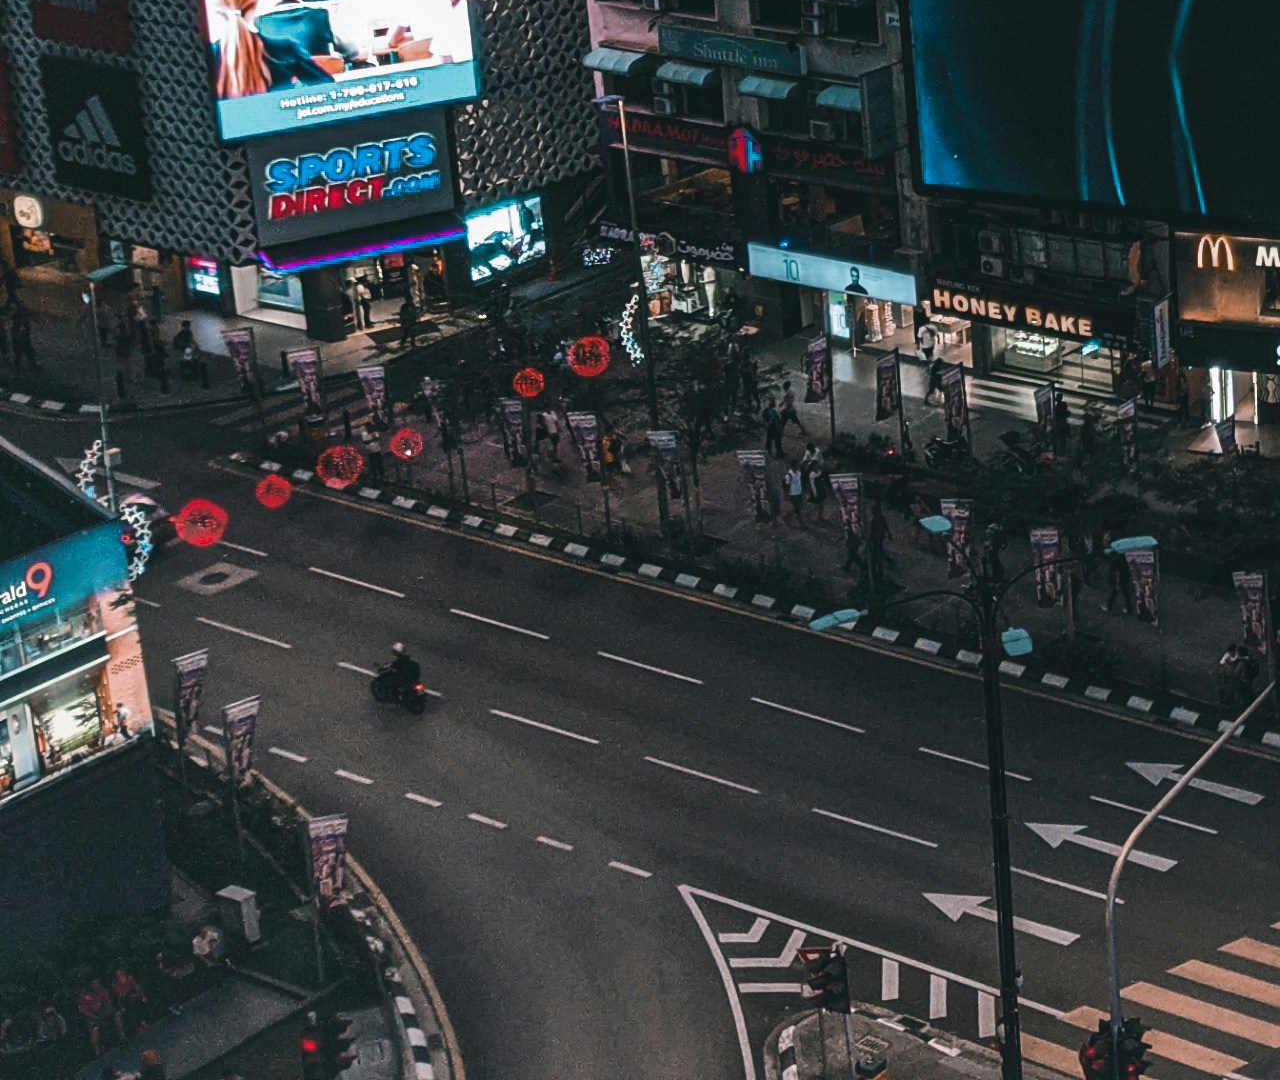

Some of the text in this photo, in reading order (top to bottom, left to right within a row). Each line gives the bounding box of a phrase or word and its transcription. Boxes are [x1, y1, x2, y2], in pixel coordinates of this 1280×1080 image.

[693, 42, 749, 64] Shuttle
[280, 93, 327, 109] Hotline:
[58, 139, 137, 176] adidas
[264, 131, 437, 194] SPORTS
[268, 169, 442, 221] DIRECT.COM
[933, 288, 1093, 337] HONEY BAKE
